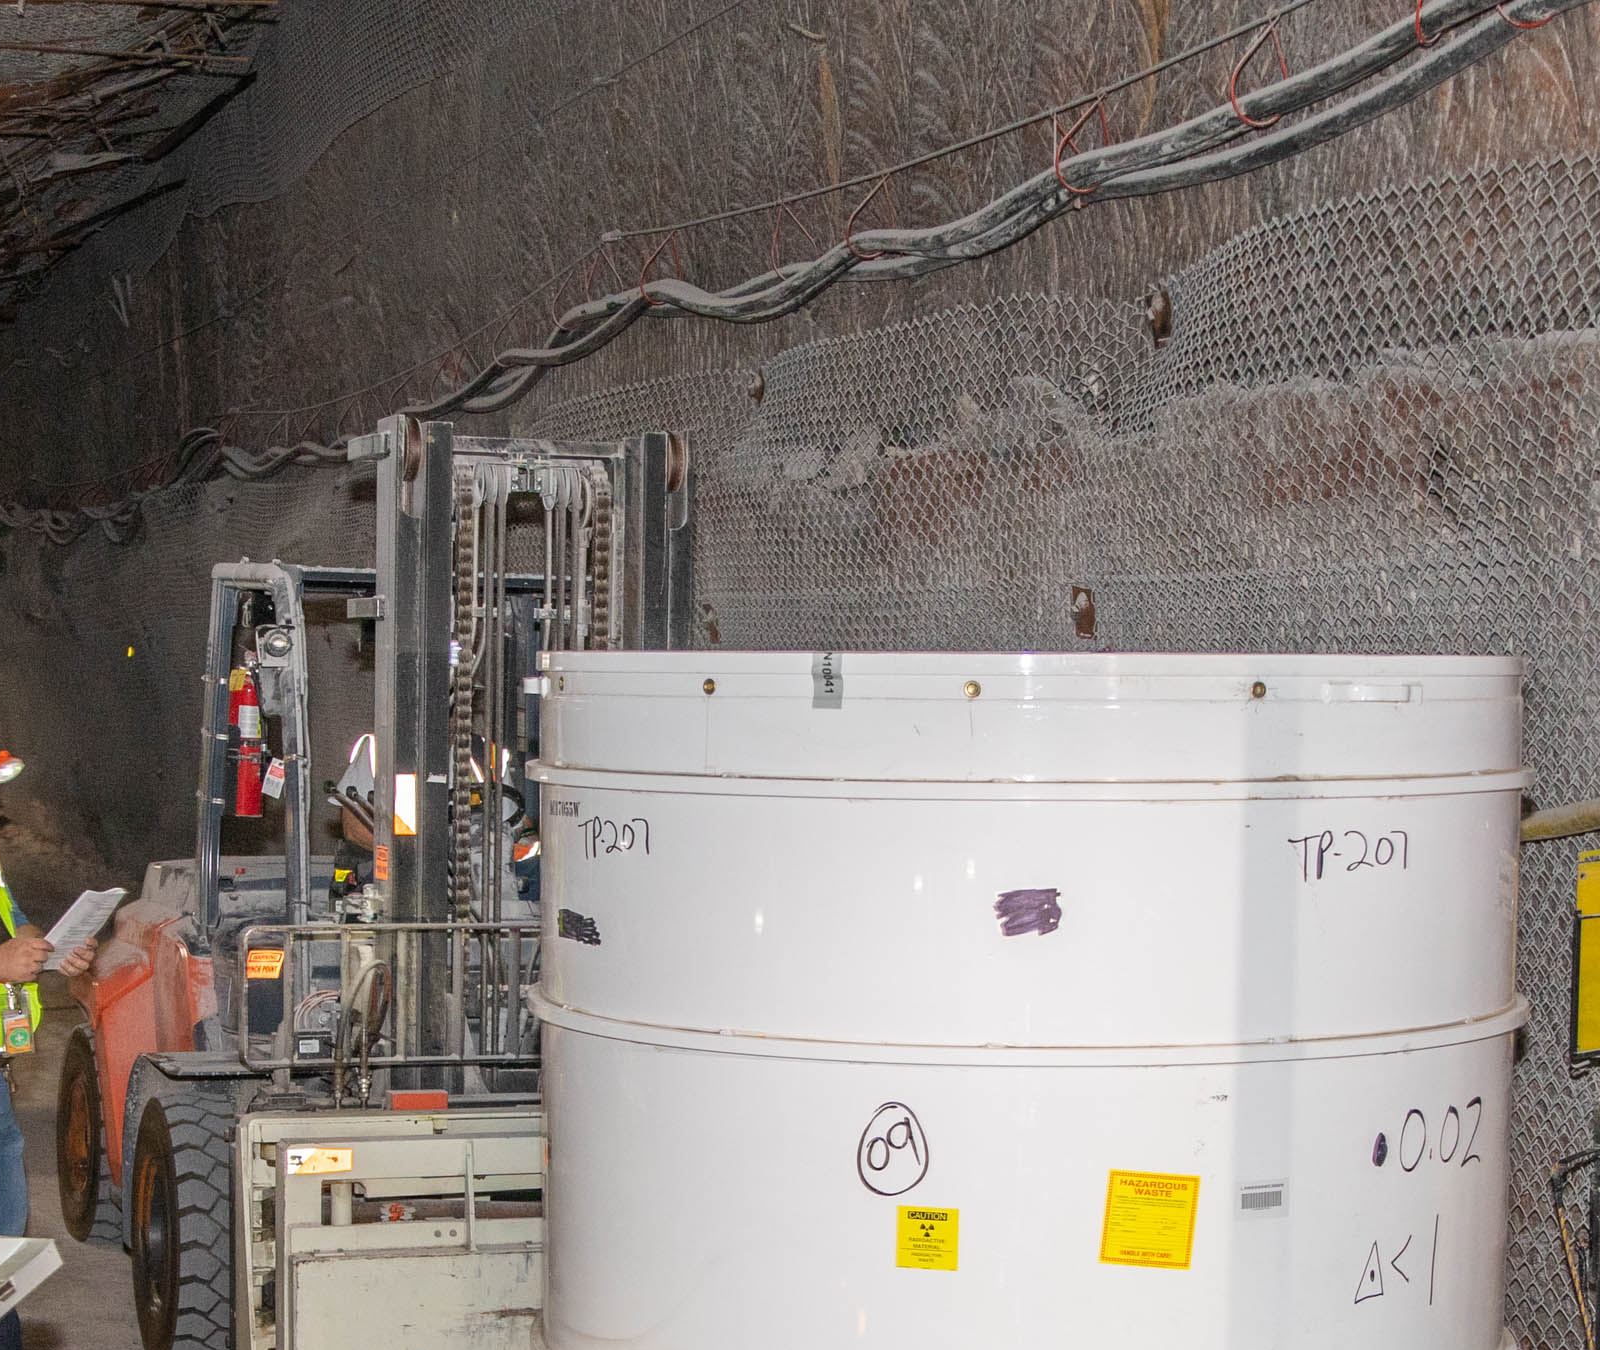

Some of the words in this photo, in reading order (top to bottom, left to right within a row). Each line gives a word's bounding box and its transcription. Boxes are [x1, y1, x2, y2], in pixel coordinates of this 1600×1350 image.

[1288, 830, 1408, 883] TP-207
[866, 1116, 921, 1171] 09
[1400, 1096, 1482, 1172] 0.02
[1120, 1179, 1188, 1191] HAZARDOUS
[1135, 1188, 1173, 1198] WASTE
[910, 1211, 947, 1220] CAUTION
